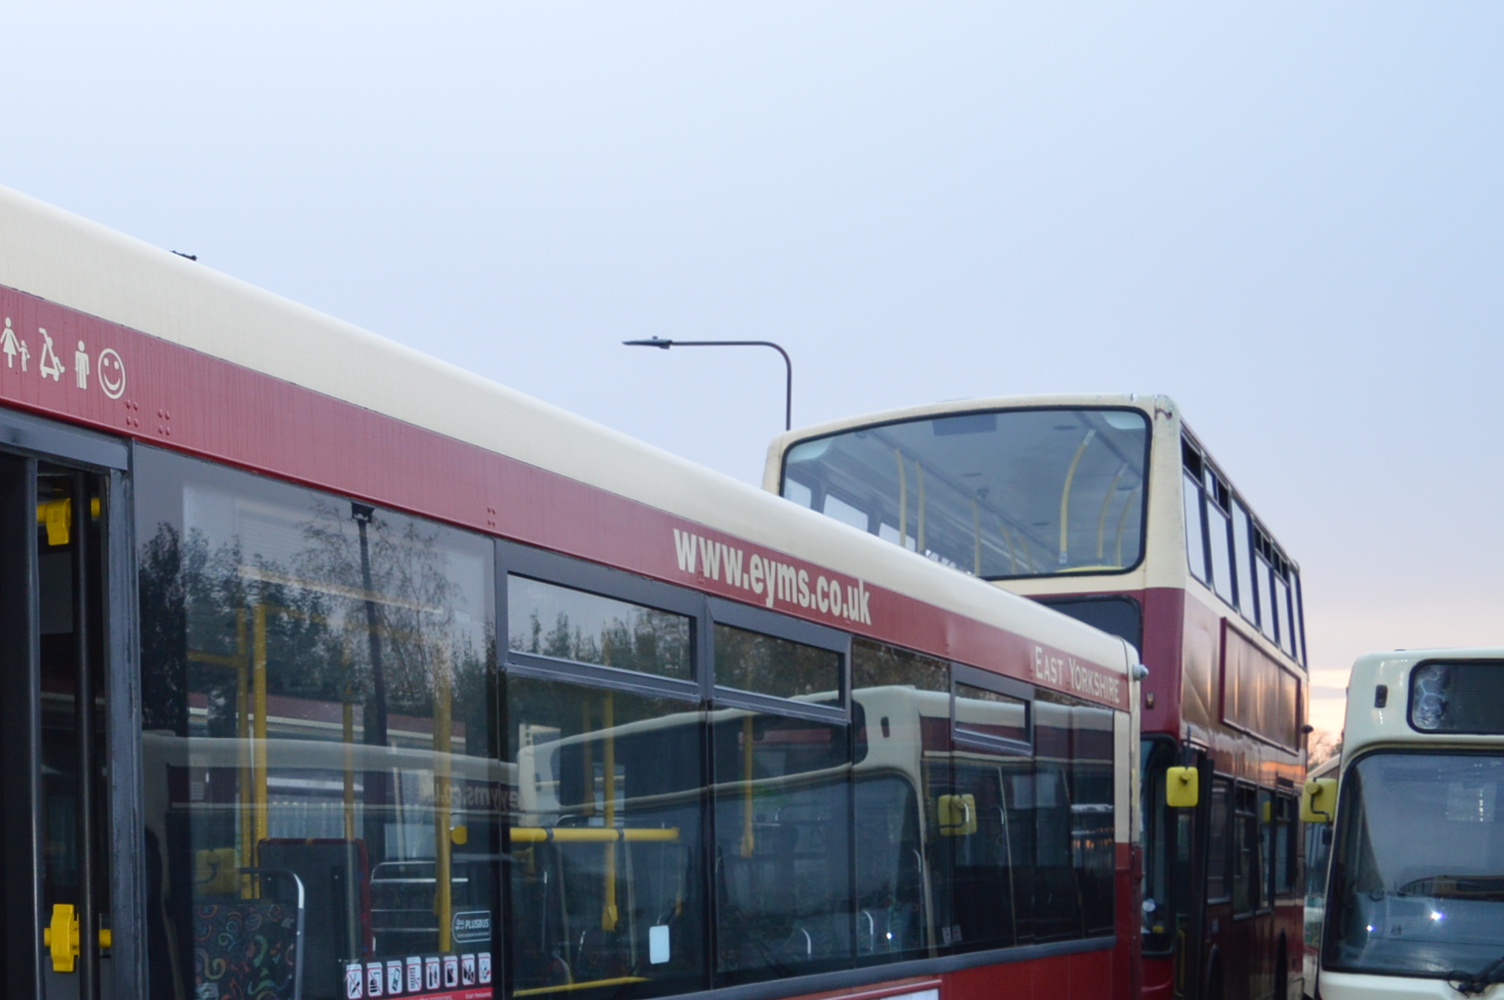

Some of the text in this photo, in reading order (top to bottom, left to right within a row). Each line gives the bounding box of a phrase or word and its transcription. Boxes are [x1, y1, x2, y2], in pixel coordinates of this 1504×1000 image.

[673, 527, 872, 626] www.eyms.co.uk
[1034, 645, 1120, 704] EAST YORKSHIRE
[464, 917, 490, 930] PLUSBUS
